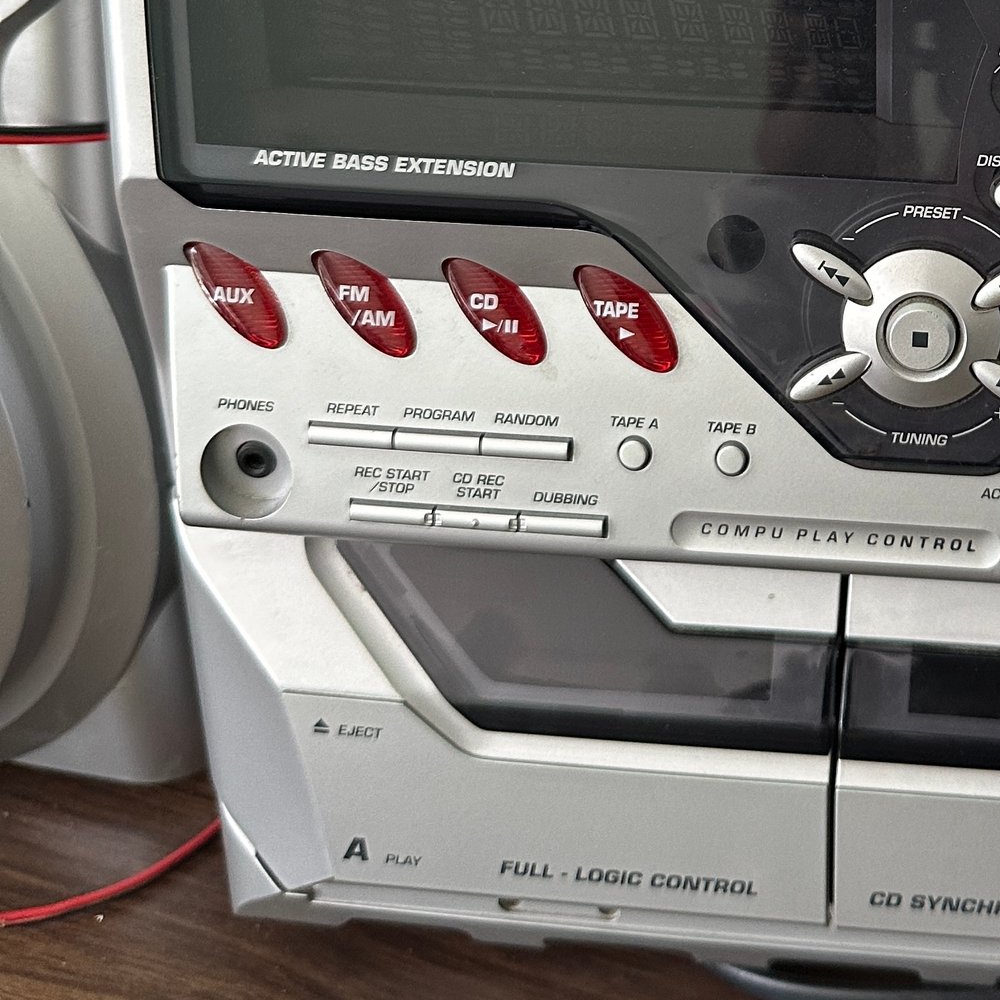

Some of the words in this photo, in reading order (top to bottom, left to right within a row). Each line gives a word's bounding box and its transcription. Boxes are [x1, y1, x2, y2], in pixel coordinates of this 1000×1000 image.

[253, 149, 327, 169] ACTIVE
[332, 153, 389, 172] BASS
[394, 156, 516, 178] EXTENSION
[902, 204, 961, 220] PRESET
[213, 286, 255, 305] AUX
[338, 284, 370, 302] FM
[470, 293, 499, 311] CD
[593, 300, 640, 320] TAPE
[217, 397, 275, 413] PHONES
[327, 402, 380, 417] REPEAT
[403, 407, 476, 423] PROGRAM
[494, 412, 560, 427] RANDOM
[610, 415, 644, 429] TAPE
[645, 416, 660, 430] A
[707, 420, 742, 435] TAPE
[745, 422, 757, 435] B
[890, 431, 949, 446] TUNING
[354, 466, 382, 480] REC
[385, 467, 430, 482] START
[452, 472, 473, 485] CD
[477, 473, 505, 487] REC
[456, 486, 501, 500] START
[533, 491, 599, 507] DUBBING
[700, 522, 784, 541] COMPU
[796, 528, 855, 545] PLAY
[866, 533, 978, 553] CONTROL
[337, 724, 383, 739] EJECT
[342, 836, 370, 862] A
[385, 853, 422, 867] PLAY
[500, 859, 555, 880] FULL
[574, 866, 644, 888] LOGIC
[650, 872, 759, 897] CONTROL
[868, 890, 903, 908] CD
